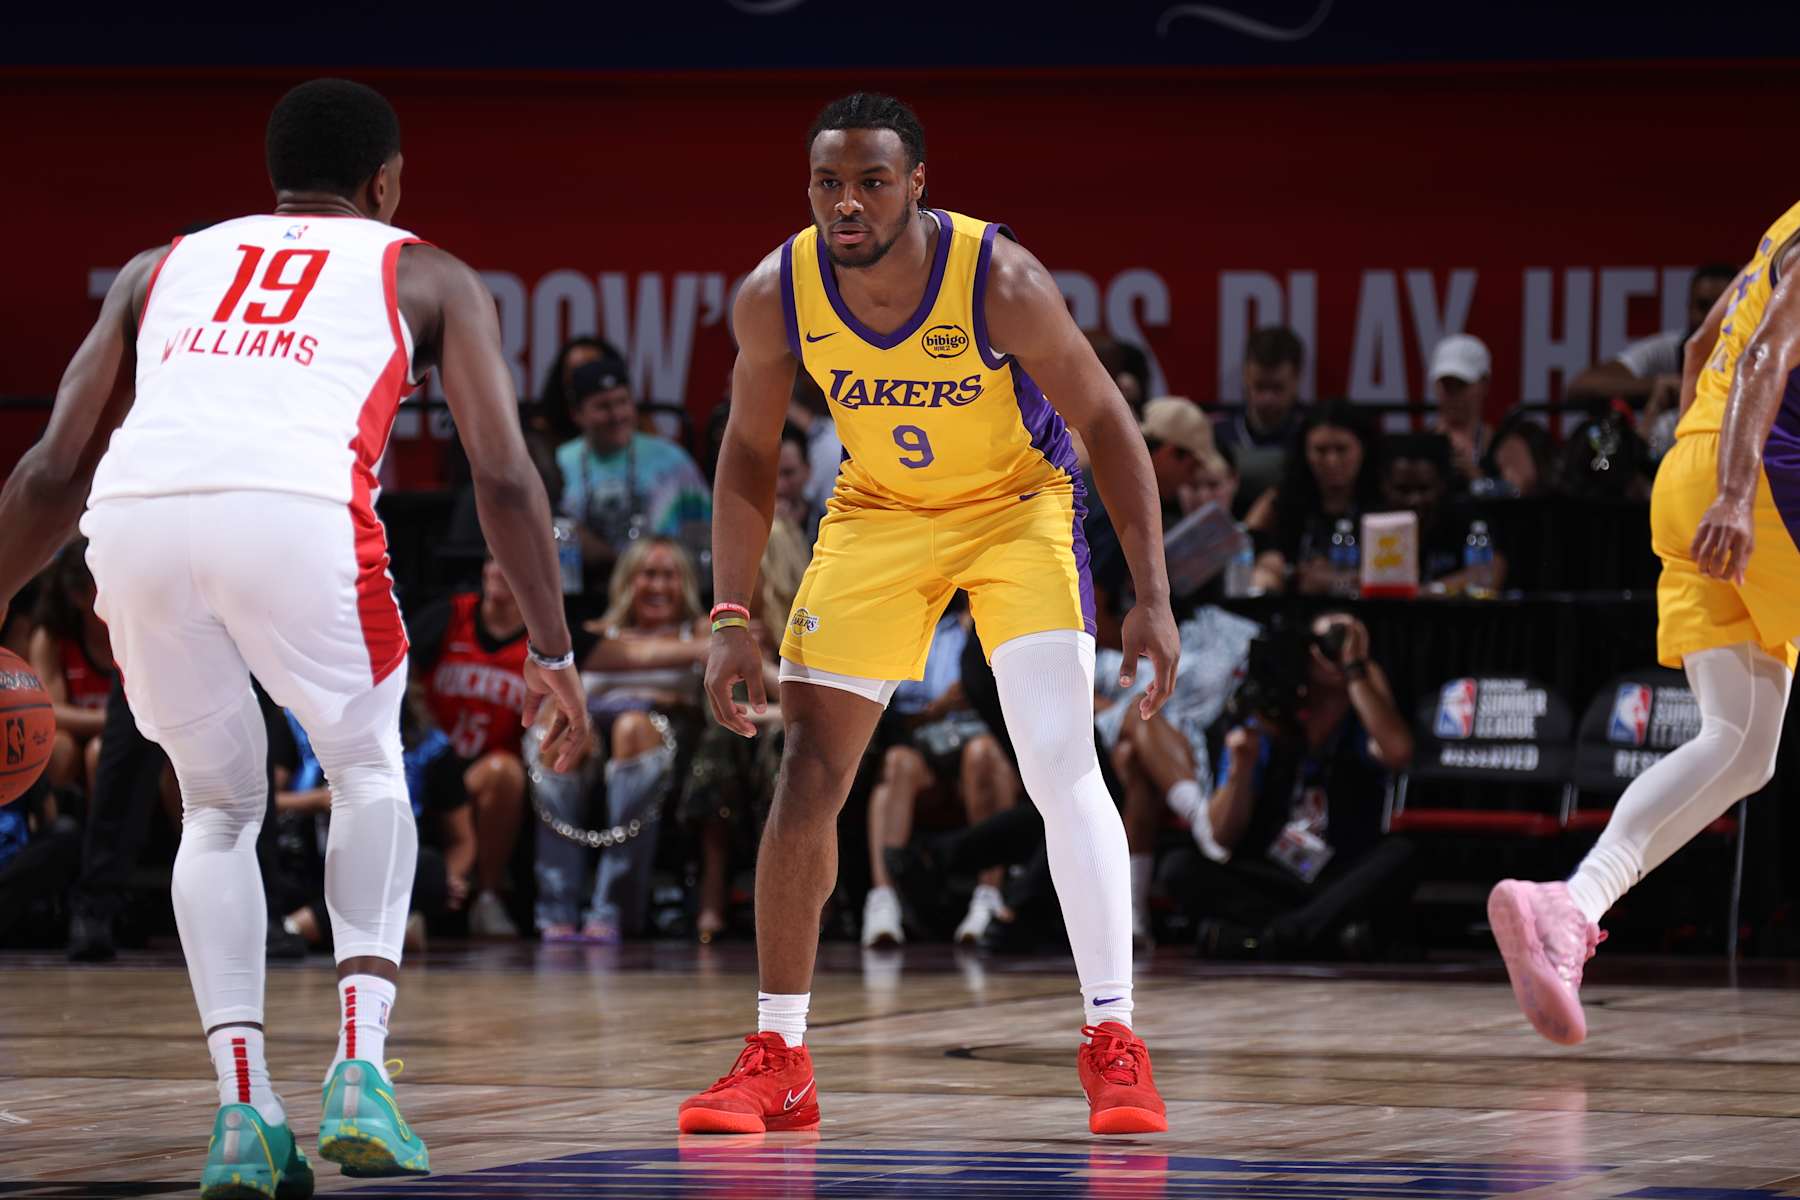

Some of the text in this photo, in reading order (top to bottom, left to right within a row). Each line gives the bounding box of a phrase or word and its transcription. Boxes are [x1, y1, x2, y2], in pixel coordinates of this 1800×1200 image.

[212, 244, 330, 324] 19
[161, 328, 319, 367] WILLIAMS
[926, 334, 966, 348] bibigo
[829, 369, 985, 410] LAKERS
[892, 425, 935, 469] 9
